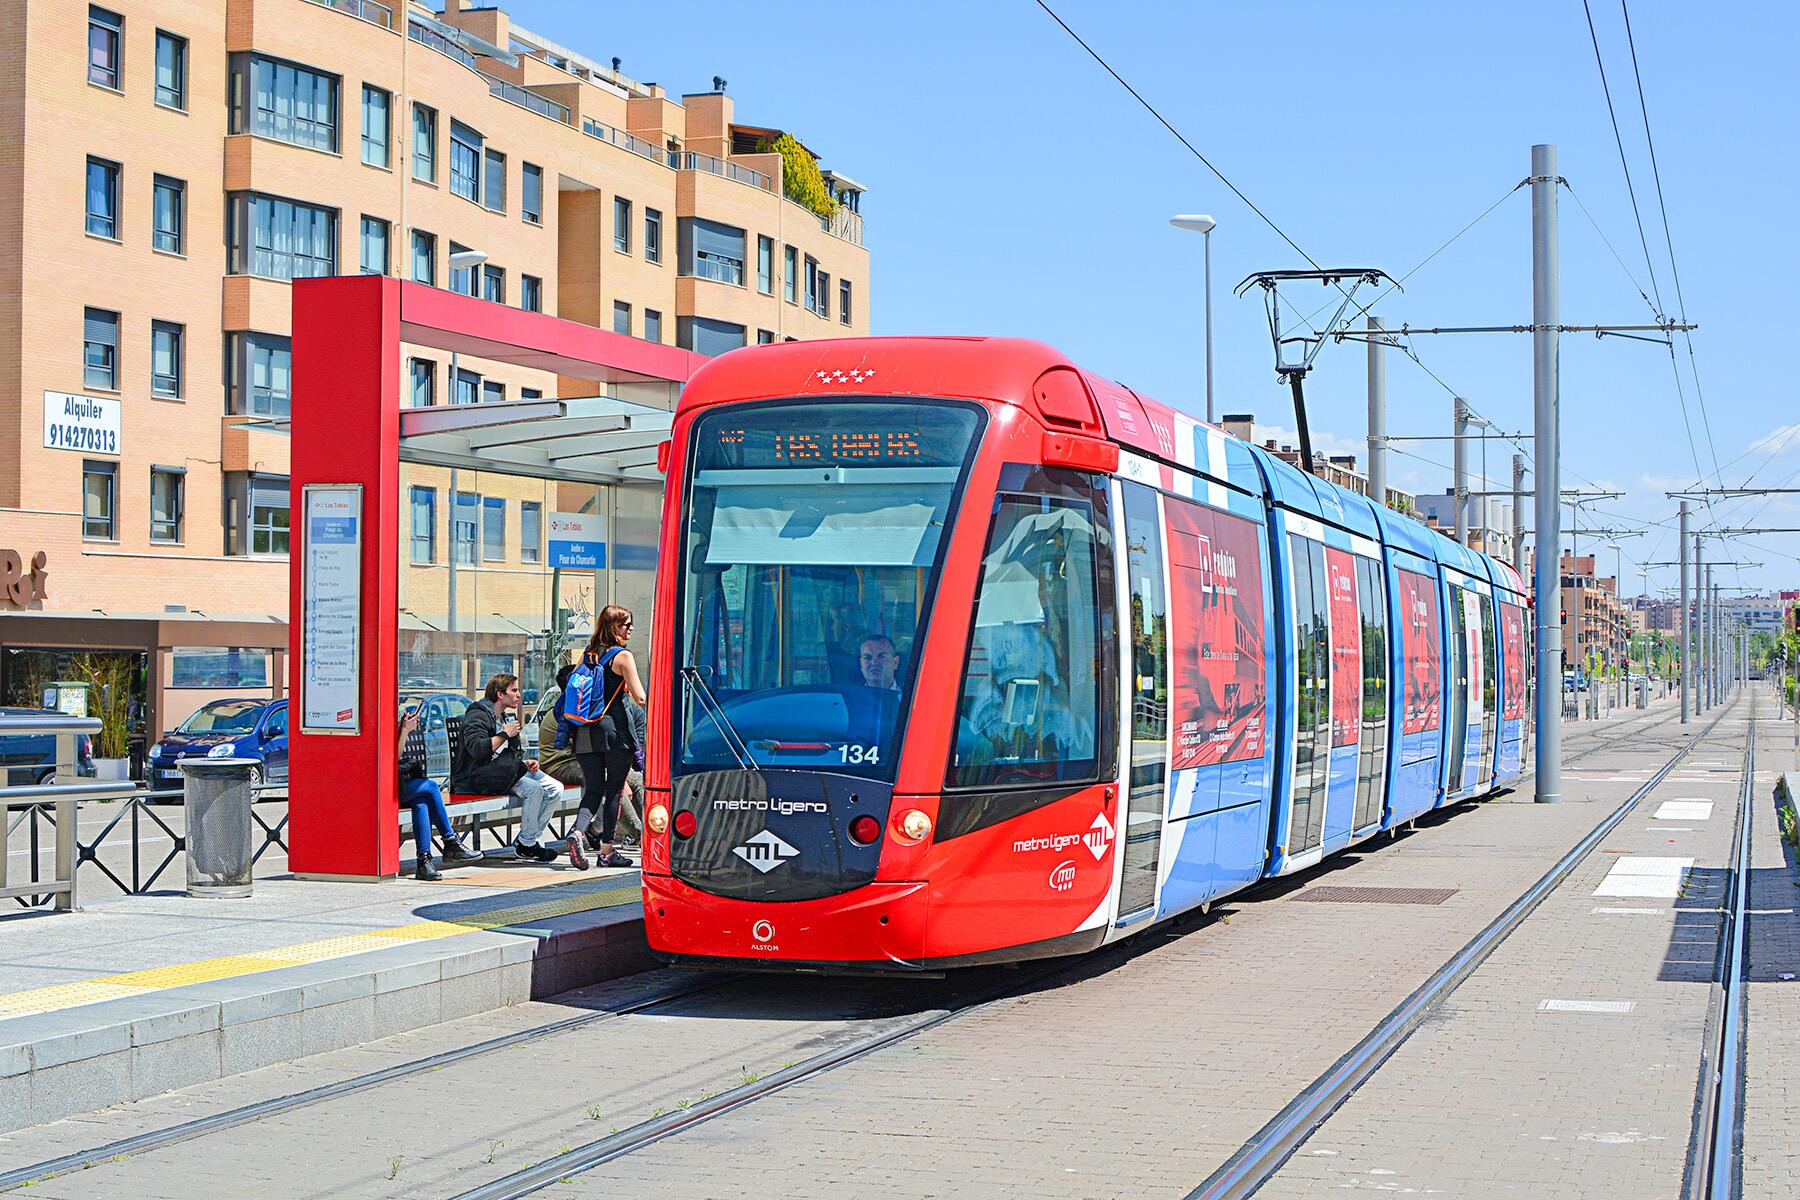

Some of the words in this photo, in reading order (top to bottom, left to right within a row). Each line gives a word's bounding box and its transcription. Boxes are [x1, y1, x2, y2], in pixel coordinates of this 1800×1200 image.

[64, 397, 103, 422] Alquiler
[50, 423, 116, 452] 914270313
[839, 745, 880, 765] 134
[713, 798, 768, 811] metro
[770, 798, 827, 815] ligero
[1013, 836, 1049, 853] metro
[1049, 832, 1080, 852] ligero
